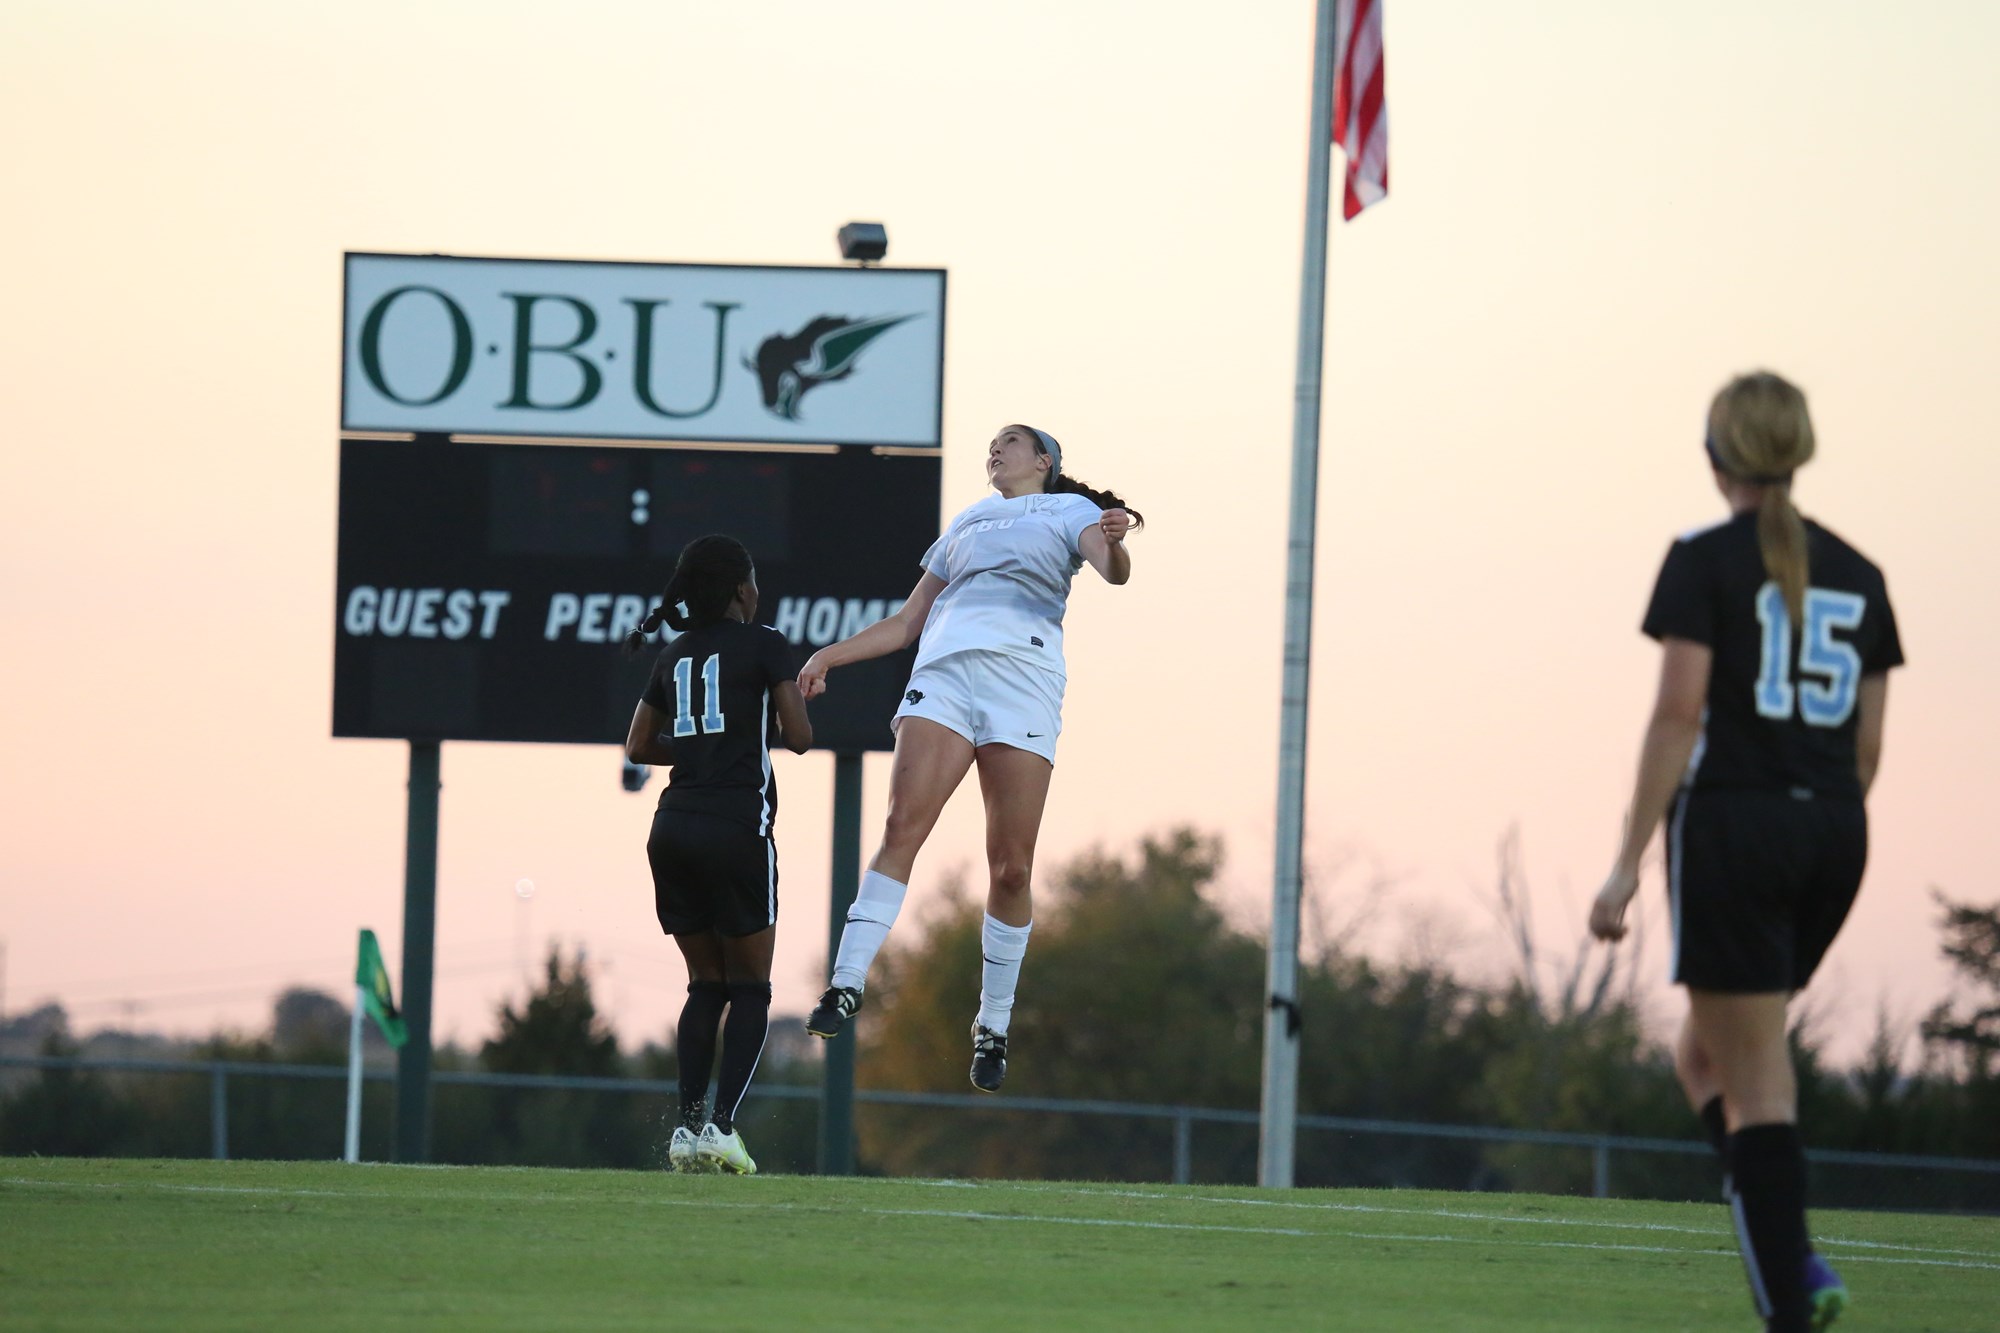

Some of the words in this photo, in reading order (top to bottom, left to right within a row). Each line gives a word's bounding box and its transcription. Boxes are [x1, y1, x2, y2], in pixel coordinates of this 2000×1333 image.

[344, 586, 511, 638] GUEST
[1754, 581, 1866, 727] 15
[673, 653, 725, 738] 11
